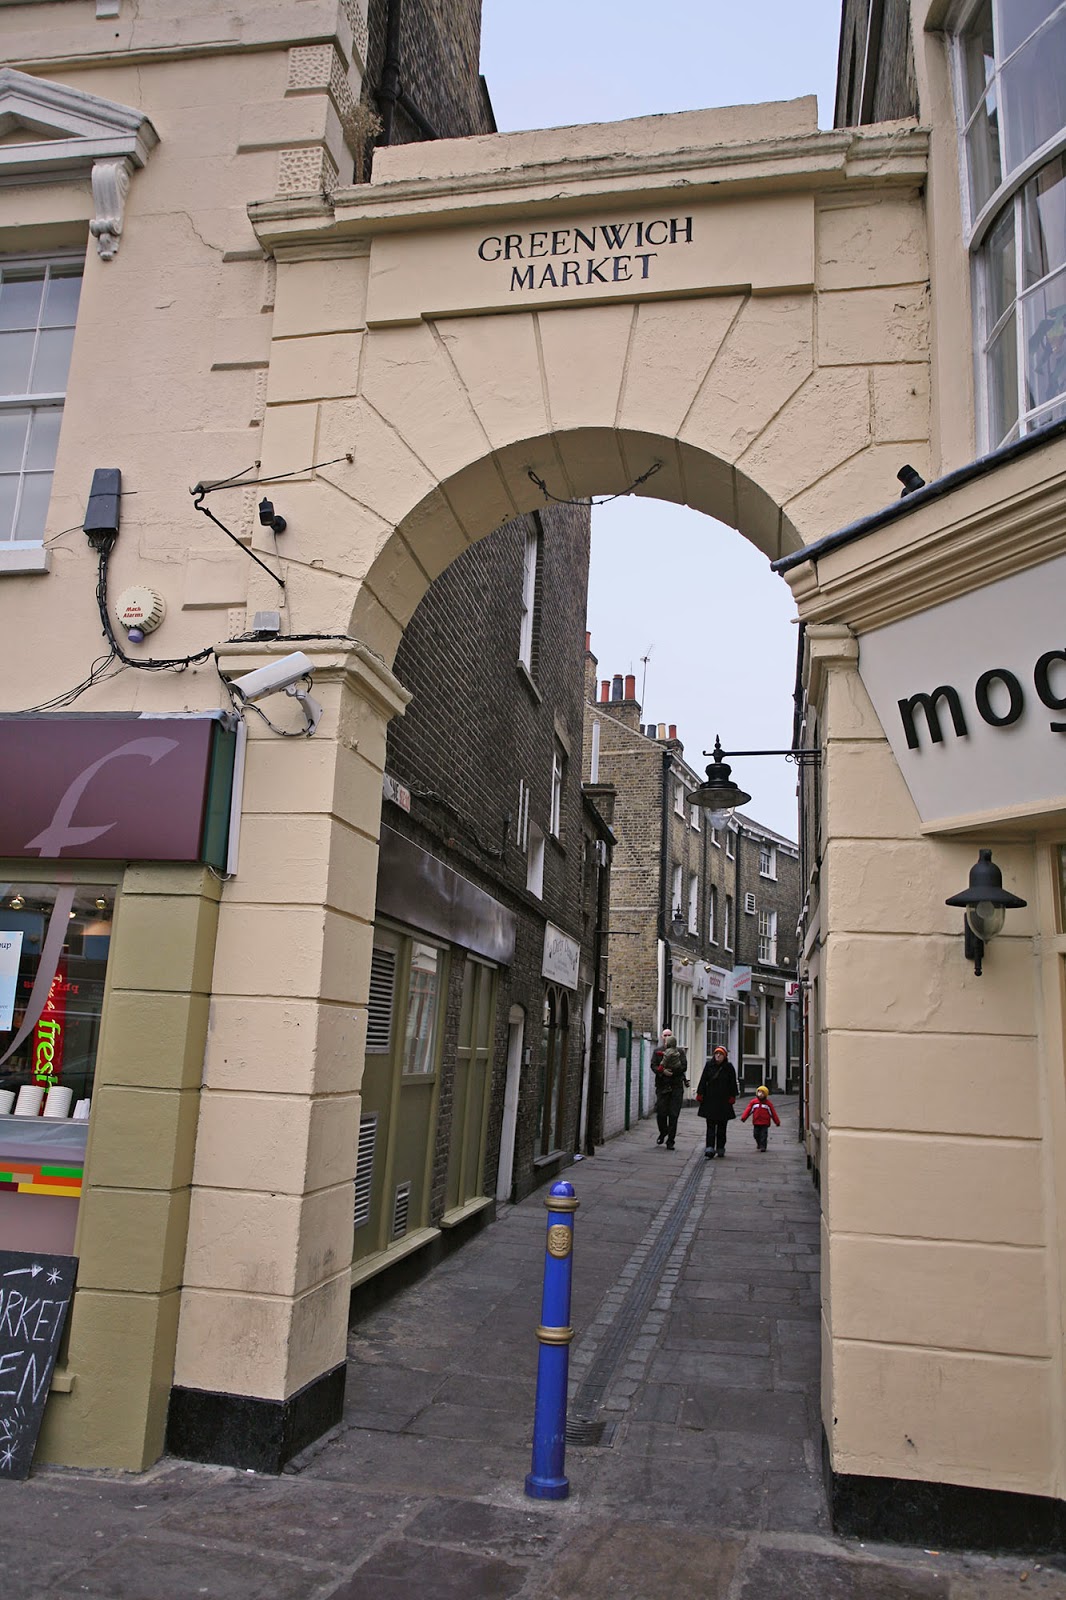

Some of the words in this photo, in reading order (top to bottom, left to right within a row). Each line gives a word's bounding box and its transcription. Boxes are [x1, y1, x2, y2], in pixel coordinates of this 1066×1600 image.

[478, 216, 694, 262] GREENWICH
[509, 252, 658, 292] MARKET
[33, 1019, 61, 1094] fresh
